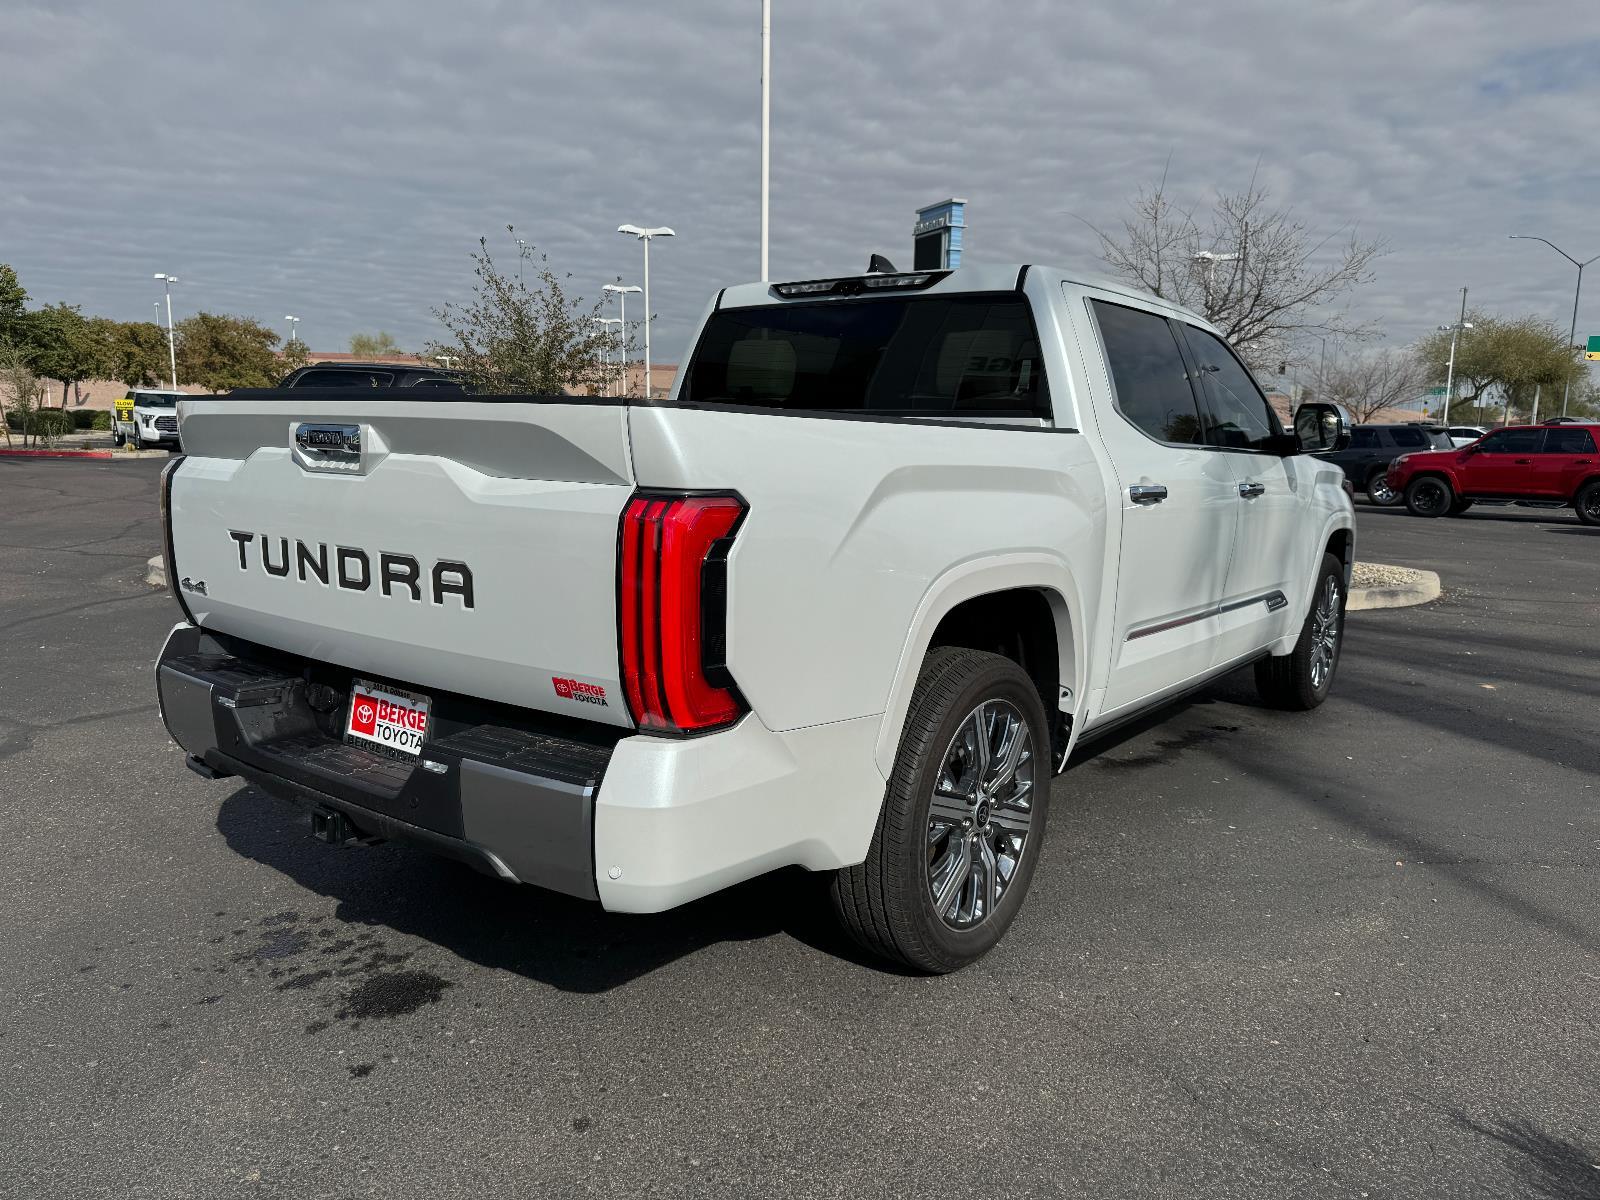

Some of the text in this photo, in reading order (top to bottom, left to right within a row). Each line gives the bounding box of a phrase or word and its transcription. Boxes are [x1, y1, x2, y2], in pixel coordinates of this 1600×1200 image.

[122, 410, 129, 418] 5
[311, 431, 341, 444] TOYOTA
[227, 529, 475, 612] TUNDRA
[569, 679, 606, 697] BERGE
[573, 693, 608, 707] TOYOTA
[378, 699, 427, 732] BERGE
[377, 724, 423, 750] TOYOTA
